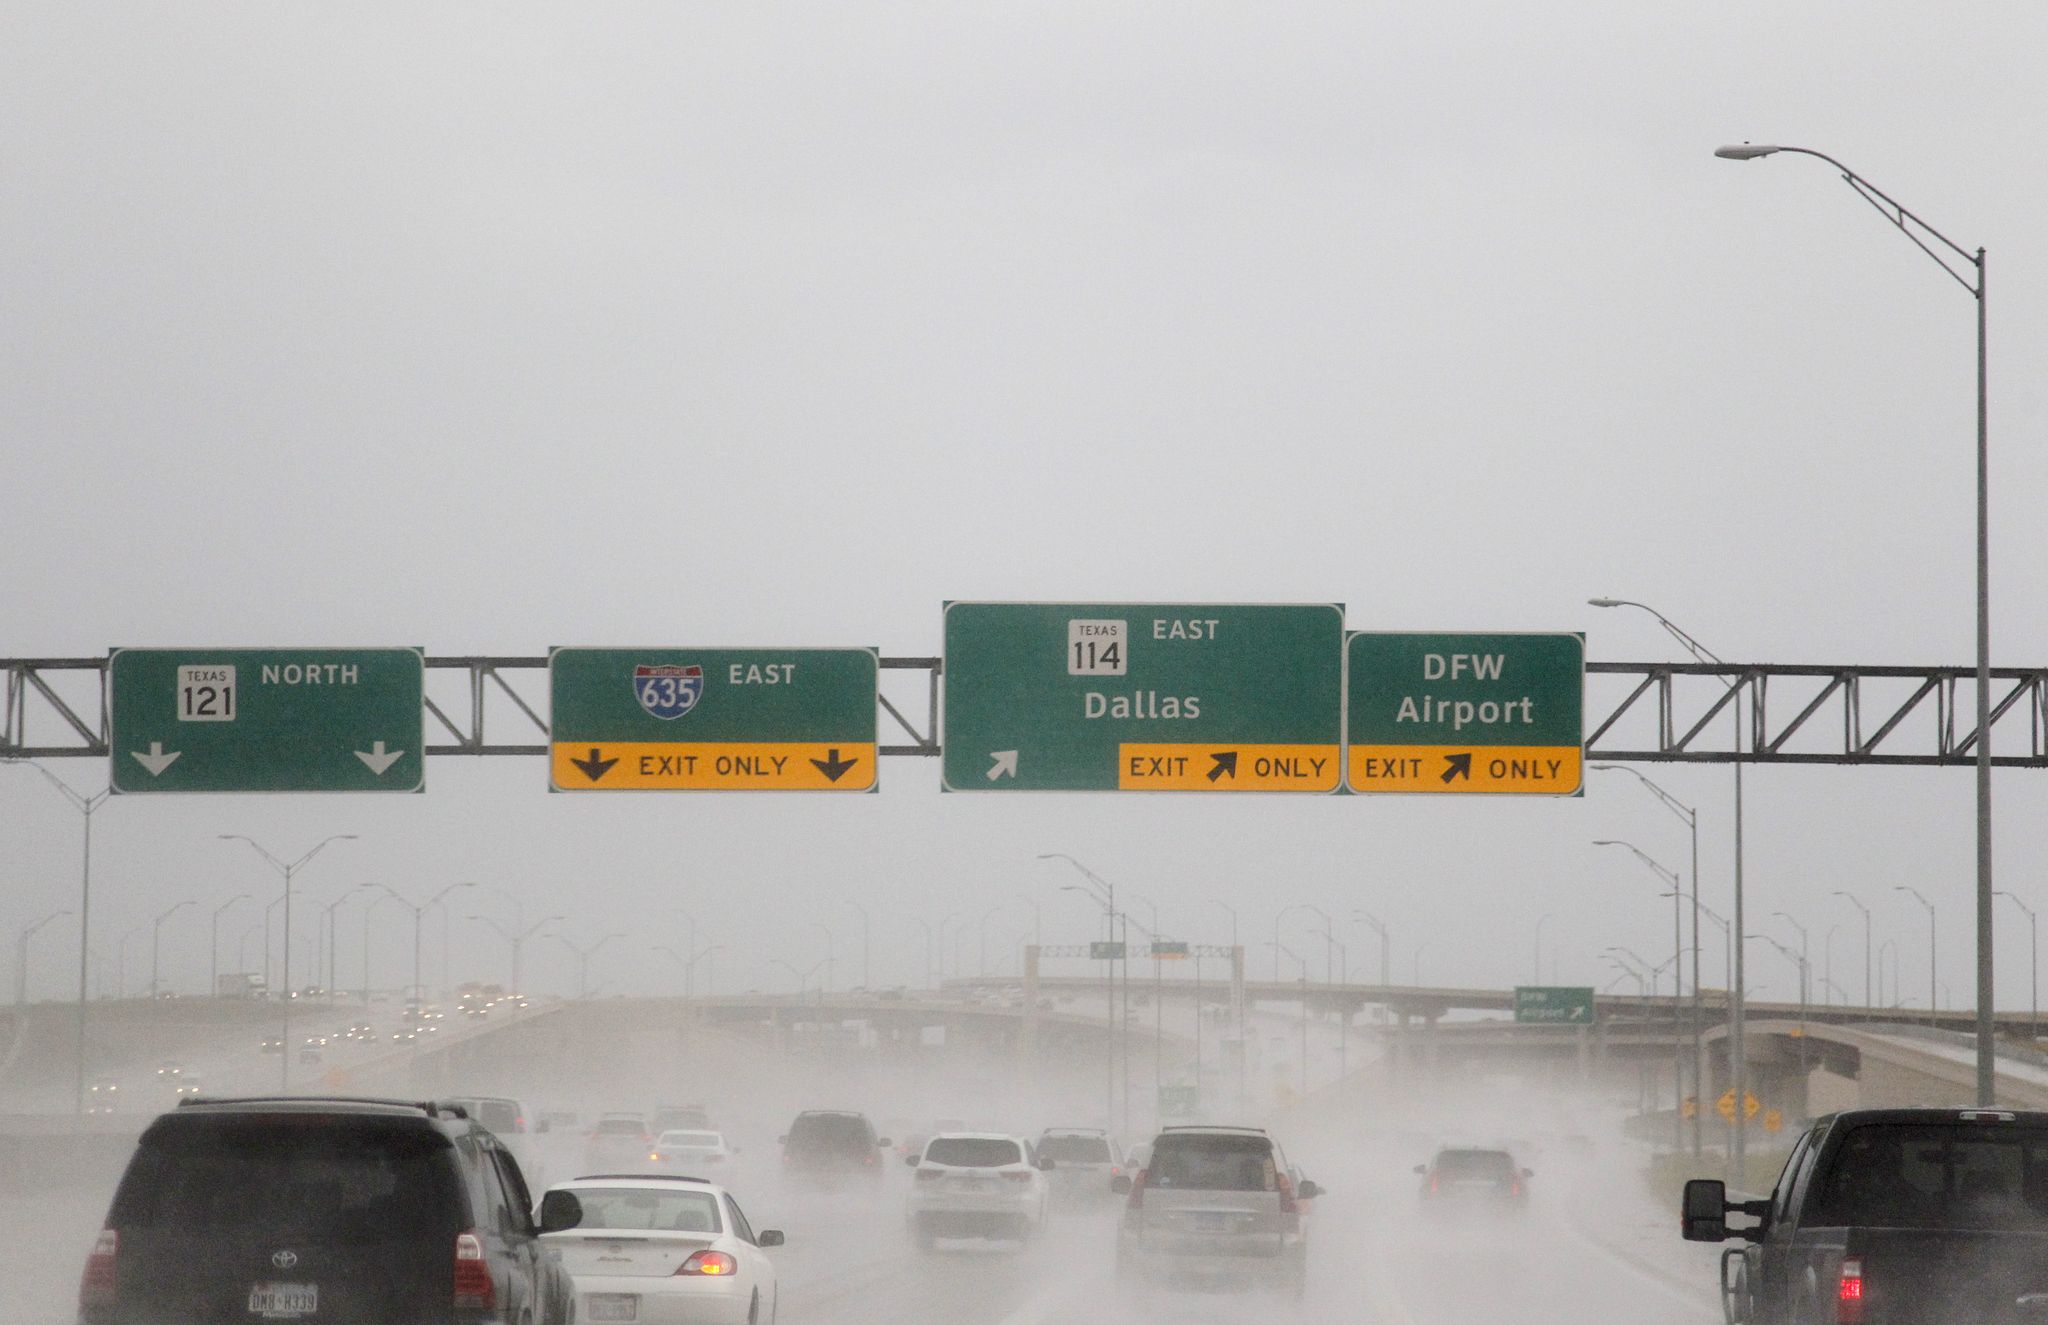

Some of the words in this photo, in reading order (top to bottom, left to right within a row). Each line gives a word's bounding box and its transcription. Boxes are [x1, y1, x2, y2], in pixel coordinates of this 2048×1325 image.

[1079, 625, 1118, 636] TEXAS
[1153, 619, 1220, 641] EAST
[1074, 641, 1121, 670] 114
[1424, 653, 1505, 680] DFW
[187, 671, 227, 682] TEXAS
[261, 664, 358, 684] NORTH
[729, 663, 796, 685] EAST
[183, 686, 231, 715] 121
[643, 678, 695, 708] 635
[1085, 691, 1201, 719] Dallas
[1396, 695, 1534, 731] Airport
[640, 756, 698, 775] EXIT
[715, 756, 788, 776] ONLY
[1130, 757, 1188, 776] EXIT
[1254, 757, 1326, 777] ONLY
[1366, 758, 1423, 778] EXIT
[1489, 759, 1562, 779] ONLY
